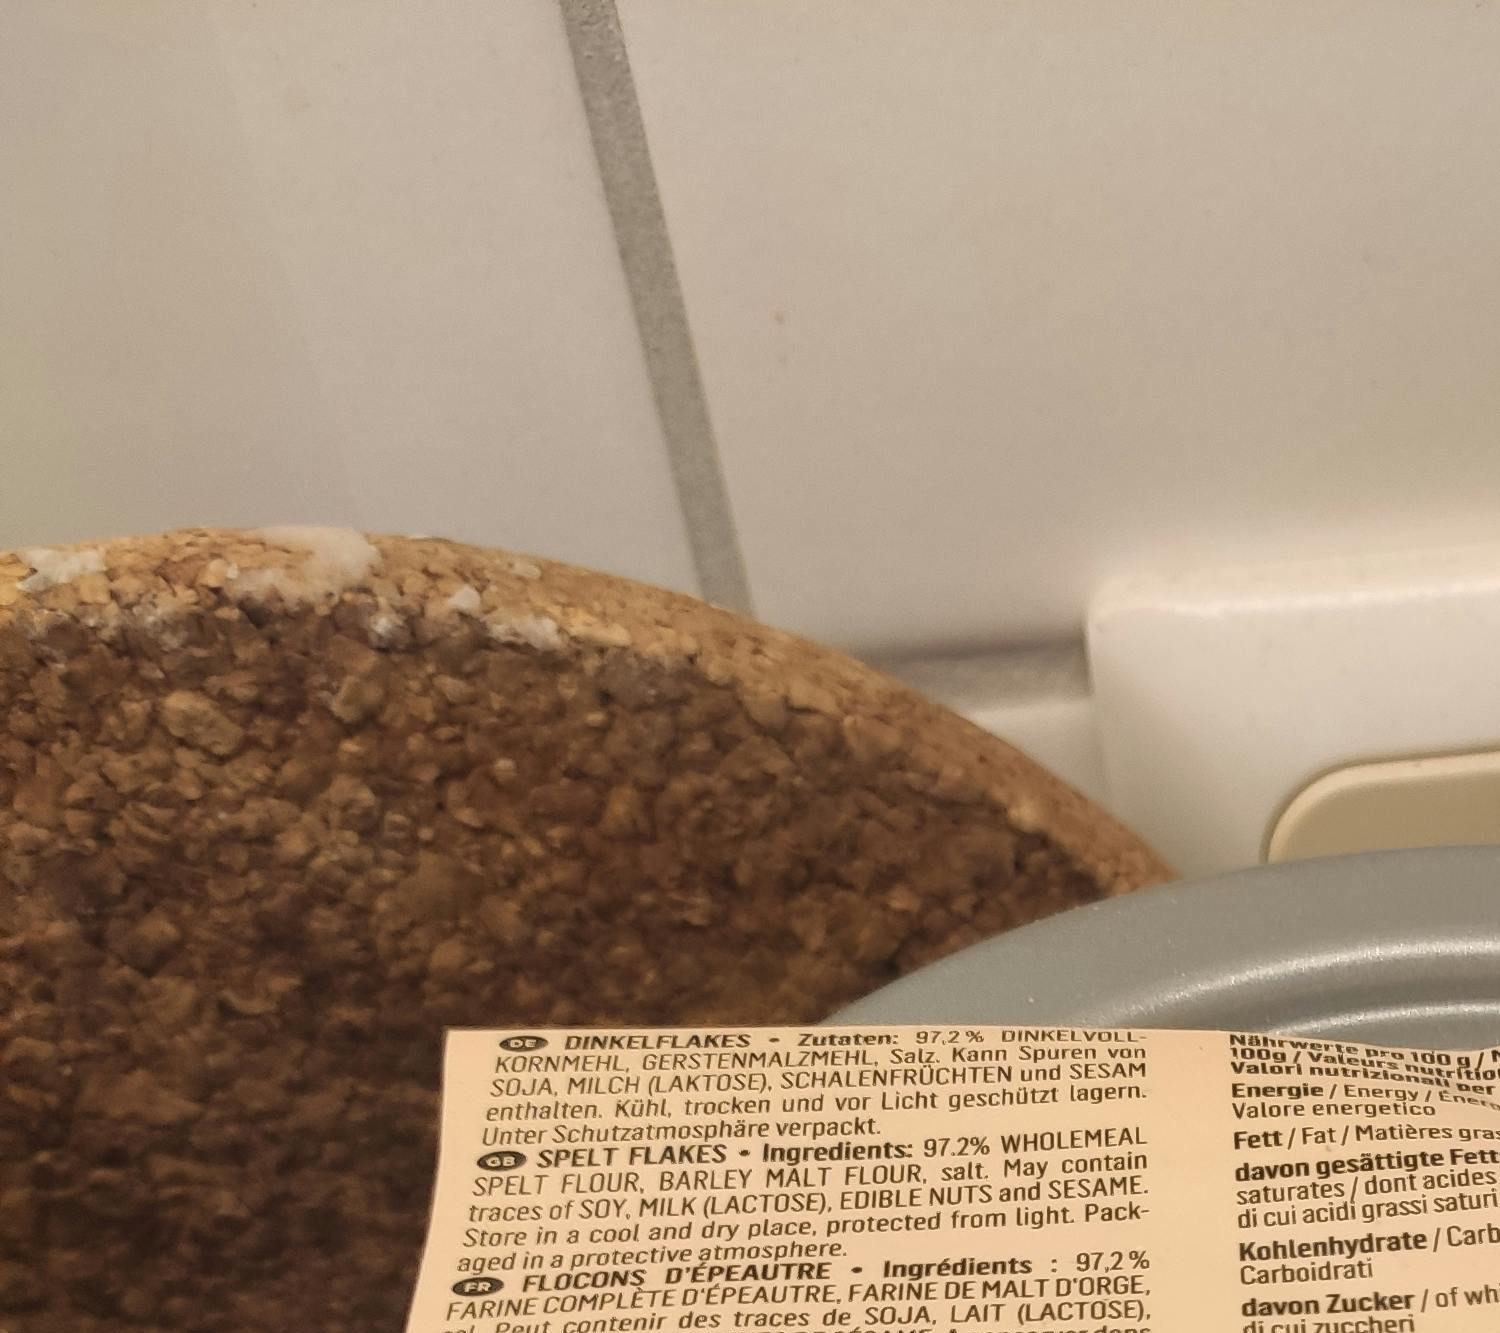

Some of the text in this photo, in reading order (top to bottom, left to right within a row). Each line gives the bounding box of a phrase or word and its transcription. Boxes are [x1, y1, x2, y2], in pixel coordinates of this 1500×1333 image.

[564, 1035, 751, 1050] DINKELFLAKES
[952, 1048, 1007, 1062] Kann
[1019, 1046, 1097, 1061] Spuren
[567, 1076, 639, 1095] MILCH
[781, 1065, 1012, 1089] SCHALENFRÜCHTEN
[1020, 1065, 1061, 1082] und
[1070, 1064, 1146, 1079] SESAM
[1232, 1083, 1418, 1102] Energie Energy
[684, 1099, 770, 1116] trocken
[782, 1093, 824, 1112] und
[835, 1096, 871, 1111] vor
[882, 1092, 937, 1110] Licht
[949, 1089, 1059, 1112] geschützt
[1232, 1100, 1436, 1119] Valore energetico
[482, 1127, 547, 1146] Unter
[552, 1120, 769, 1144] Schutzatmosphäre
[1234, 1130, 1282, 1149] Fett
[1302, 1126, 1336, 1144] Fat
[1355, 1124, 1452, 1141] Matières
[536, 1148, 619, 1169] SPELT
[629, 1145, 726, 1165] FLAKES
[924, 1136, 990, 1157] 97.2%
[1001, 1127, 1148, 1154] WHOLEMEAL
[472, 1175, 549, 1197] SPELT
[659, 1169, 752, 1191] BARLEY
[766, 1167, 832, 1188] MALT
[1003, 1159, 1048, 1179] May
[1061, 1155, 1148, 1174] contain
[1235, 1162, 1309, 1182] davon
[1316, 1152, 1445, 1175] gesättigte
[1237, 1180, 1344, 1205] saturates
[1364, 1174, 1417, 1195] dont
[1423, 1167, 1497, 1189] acides
[469, 1203, 542, 1222] traces
[639, 1196, 696, 1217] MILK
[840, 1188, 923, 1210] EDIBLE
[928, 1185, 992, 1207] NUTS
[999, 1182, 1041, 1201] and
[1264, 1189, 1499, 1227] cui acidi grassi saturi
[463, 1229, 527, 1248] Store
[590, 1224, 639, 1242] cool
[649, 1222, 691, 1241] and
[701, 1221, 740, 1242] dry
[826, 1213, 941, 1237] protected
[951, 1209, 1006, 1229] from
[457, 1254, 515, 1274] aged
[571, 1246, 693, 1271] protective
[1239, 1233, 1427, 1261] Kohlenhydrate
[522, 1257, 1032, 1293] FLOCONS Ingrédients
[1241, 1258, 1373, 1285] Carboidrati
[447, 1278, 1049, 1321] FARINE COMPLÈTE FARINE MALT
[1241, 1298, 1319, 1317] davon
[1326, 1291, 1415, 1313] Zucker
[679, 1311, 721, 1329] des
[734, 1308, 809, 1328] traces
[950, 1304, 1006, 1324] LAIT
